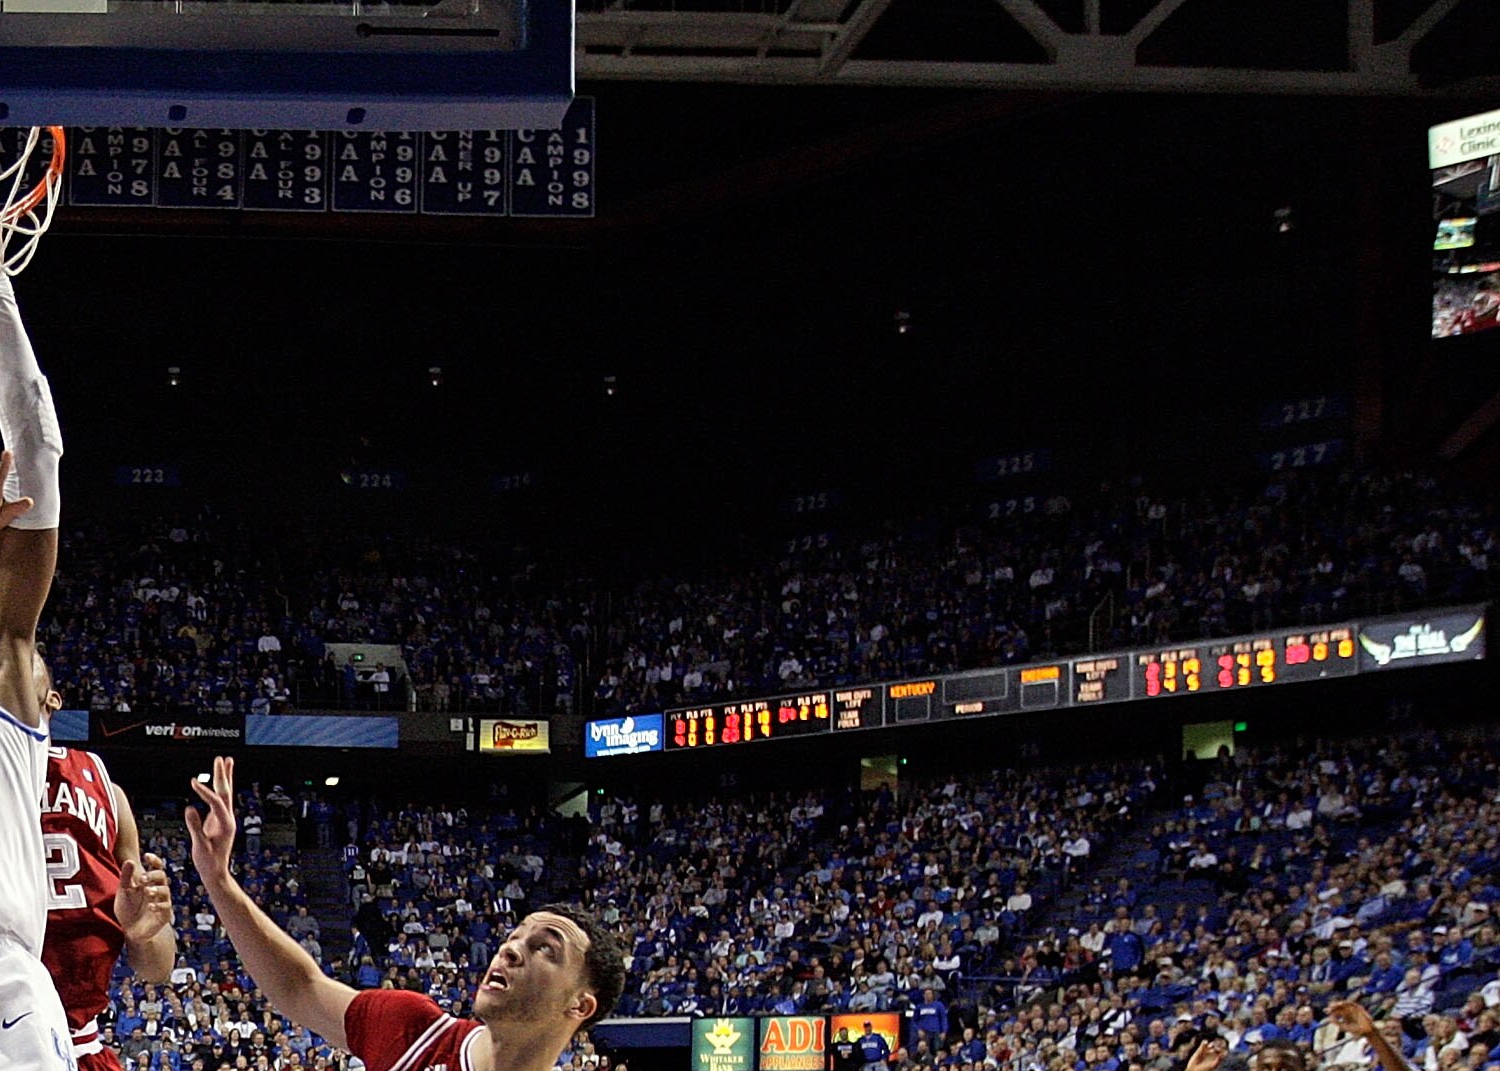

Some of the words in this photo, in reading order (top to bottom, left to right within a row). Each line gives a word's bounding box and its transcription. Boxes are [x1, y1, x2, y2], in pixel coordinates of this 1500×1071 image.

[890, 681, 935, 698] KENTUCKY
[145, 721, 201, 740] verizon
[200, 726, 240, 738] wireless
[591, 722, 619, 741] lynn
[606, 729, 659, 748] imaging
[762, 1018, 825, 1054] ADI
[700, 1053, 744, 1064] WHITAKER
[760, 1056, 825, 1070] APPLIANCES
